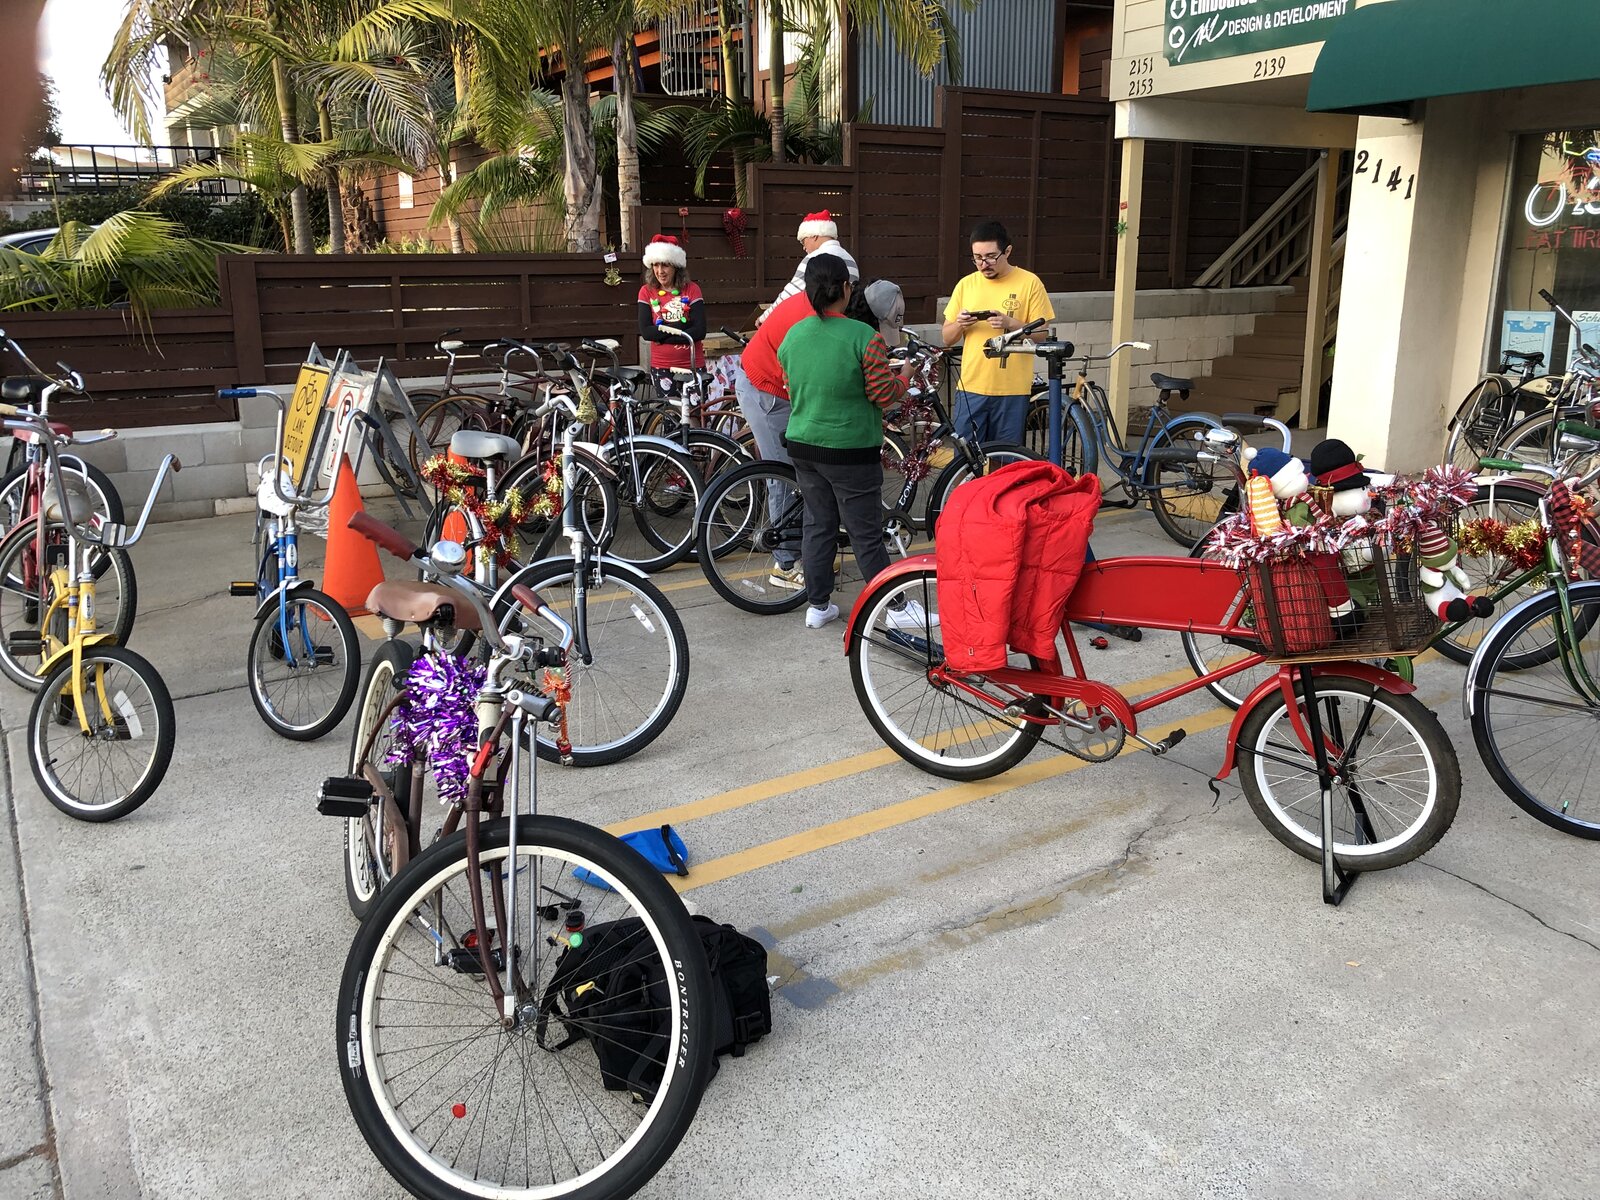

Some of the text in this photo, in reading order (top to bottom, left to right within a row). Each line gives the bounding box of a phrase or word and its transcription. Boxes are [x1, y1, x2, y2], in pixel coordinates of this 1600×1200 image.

[1190, 0, 1258, 16] Embo
[1228, 0, 1349, 36] DESIGN & DEVELOPMENT
[1129, 57, 1154, 76] 2151
[1253, 56, 1287, 79] 2139
[1128, 78, 1154, 97] 2153
[1355, 150, 1415, 200] 2141
[292, 416, 307, 434] LANE
[284, 433, 304, 455] DETOUR
[674, 959, 689, 1069] BONTRAGER
